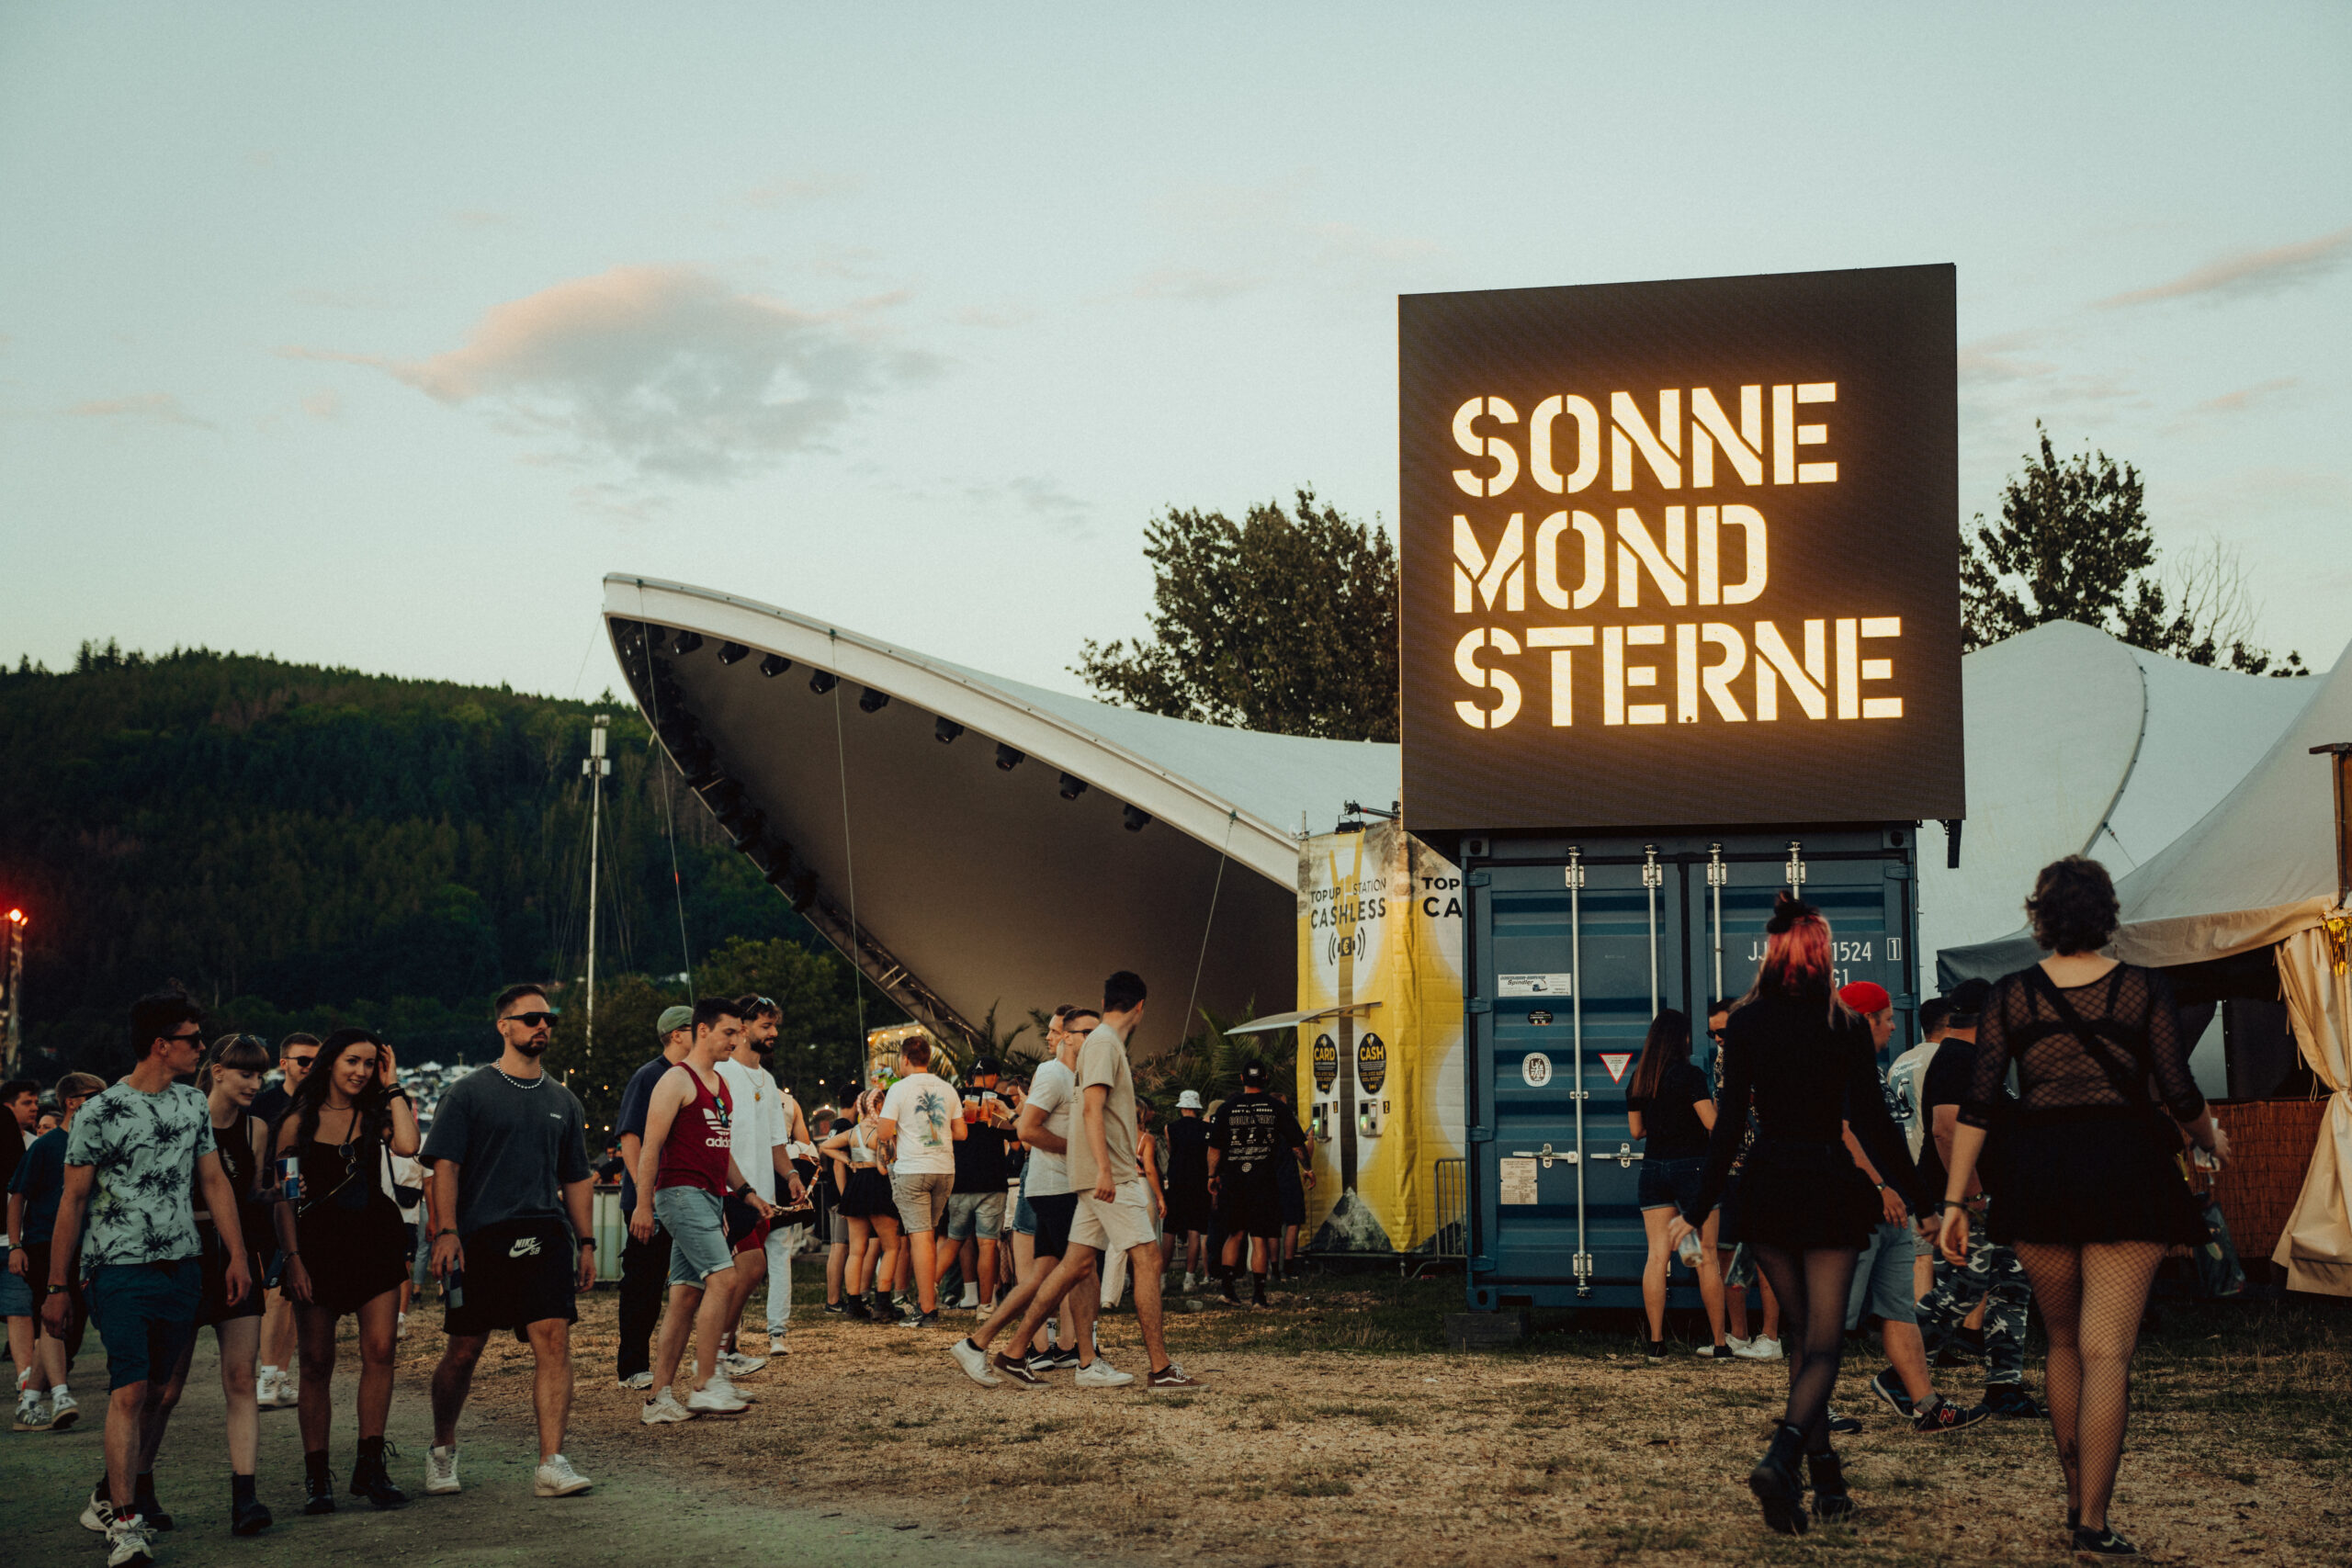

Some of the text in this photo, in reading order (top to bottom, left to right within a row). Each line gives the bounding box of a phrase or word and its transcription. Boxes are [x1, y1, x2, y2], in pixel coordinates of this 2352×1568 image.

[1452, 381, 1838, 498] SONNE
[1453, 503, 1769, 614] MOND
[1453, 616, 1904, 729] STERNE
[1352, 877, 1386, 896] STATION
[1310, 897, 1386, 930] CASHLESS
[1423, 897, 1463, 918] CA
[1747, 942, 1768, 962] JJ
[1831, 942, 1872, 962] 1524
[1832, 968, 1849, 988] G1
[1314, 1047, 1336, 1061] CARD
[1360, 1046, 1384, 1061] CASH
[514, 1236, 537, 1248] NIKE
[529, 1247, 541, 1256] SB
[1939, 1408, 1957, 1423] N
